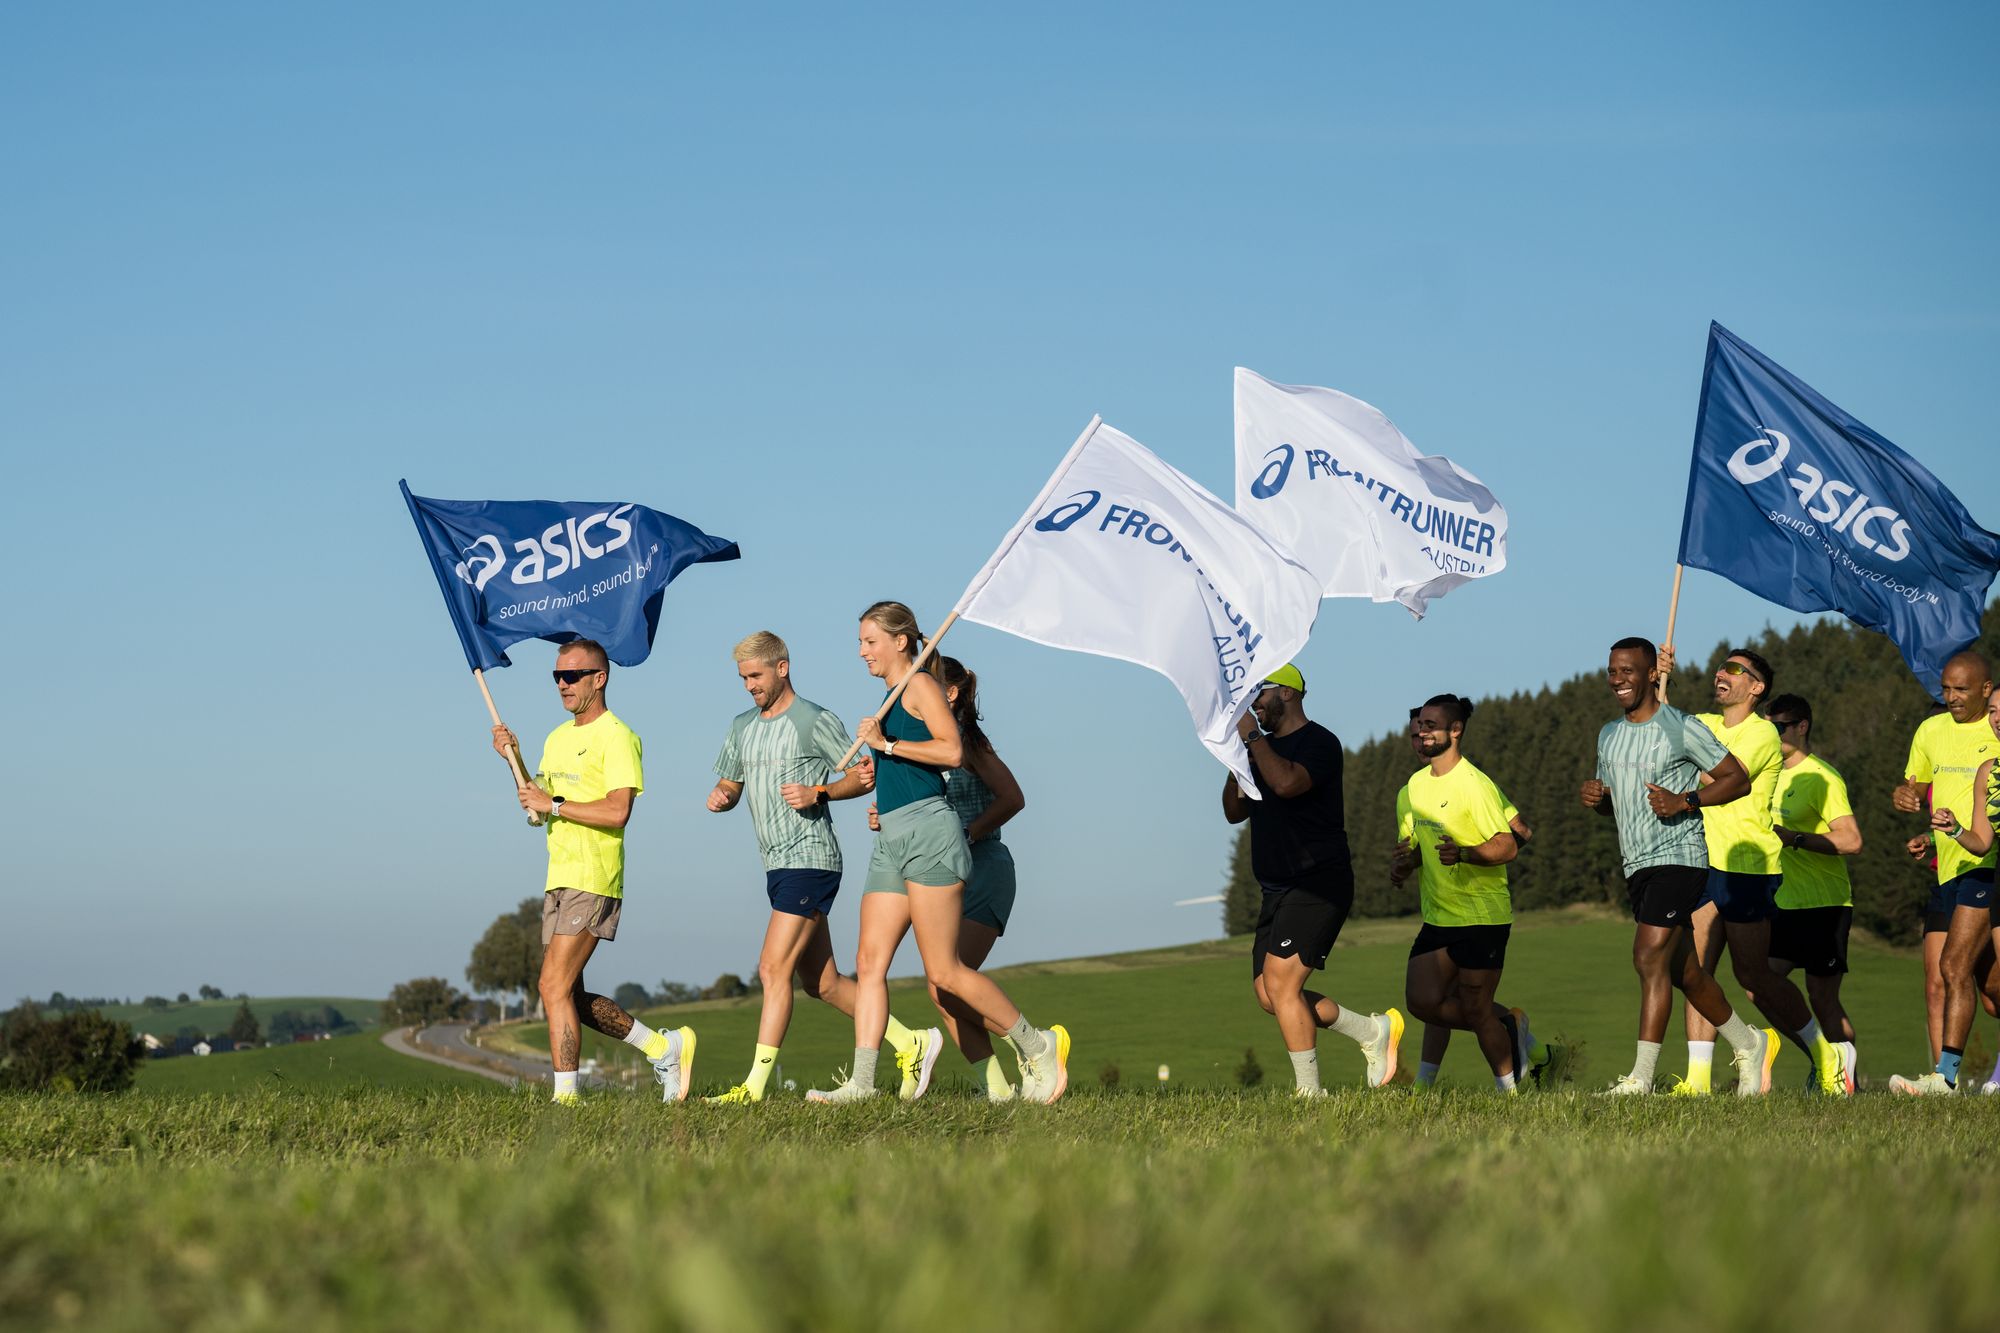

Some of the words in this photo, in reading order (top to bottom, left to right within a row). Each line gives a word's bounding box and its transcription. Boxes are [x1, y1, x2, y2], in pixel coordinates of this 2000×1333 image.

[499, 595, 549, 619] sound
[551, 584, 590, 610] mind,
[592, 564, 632, 597] sound
